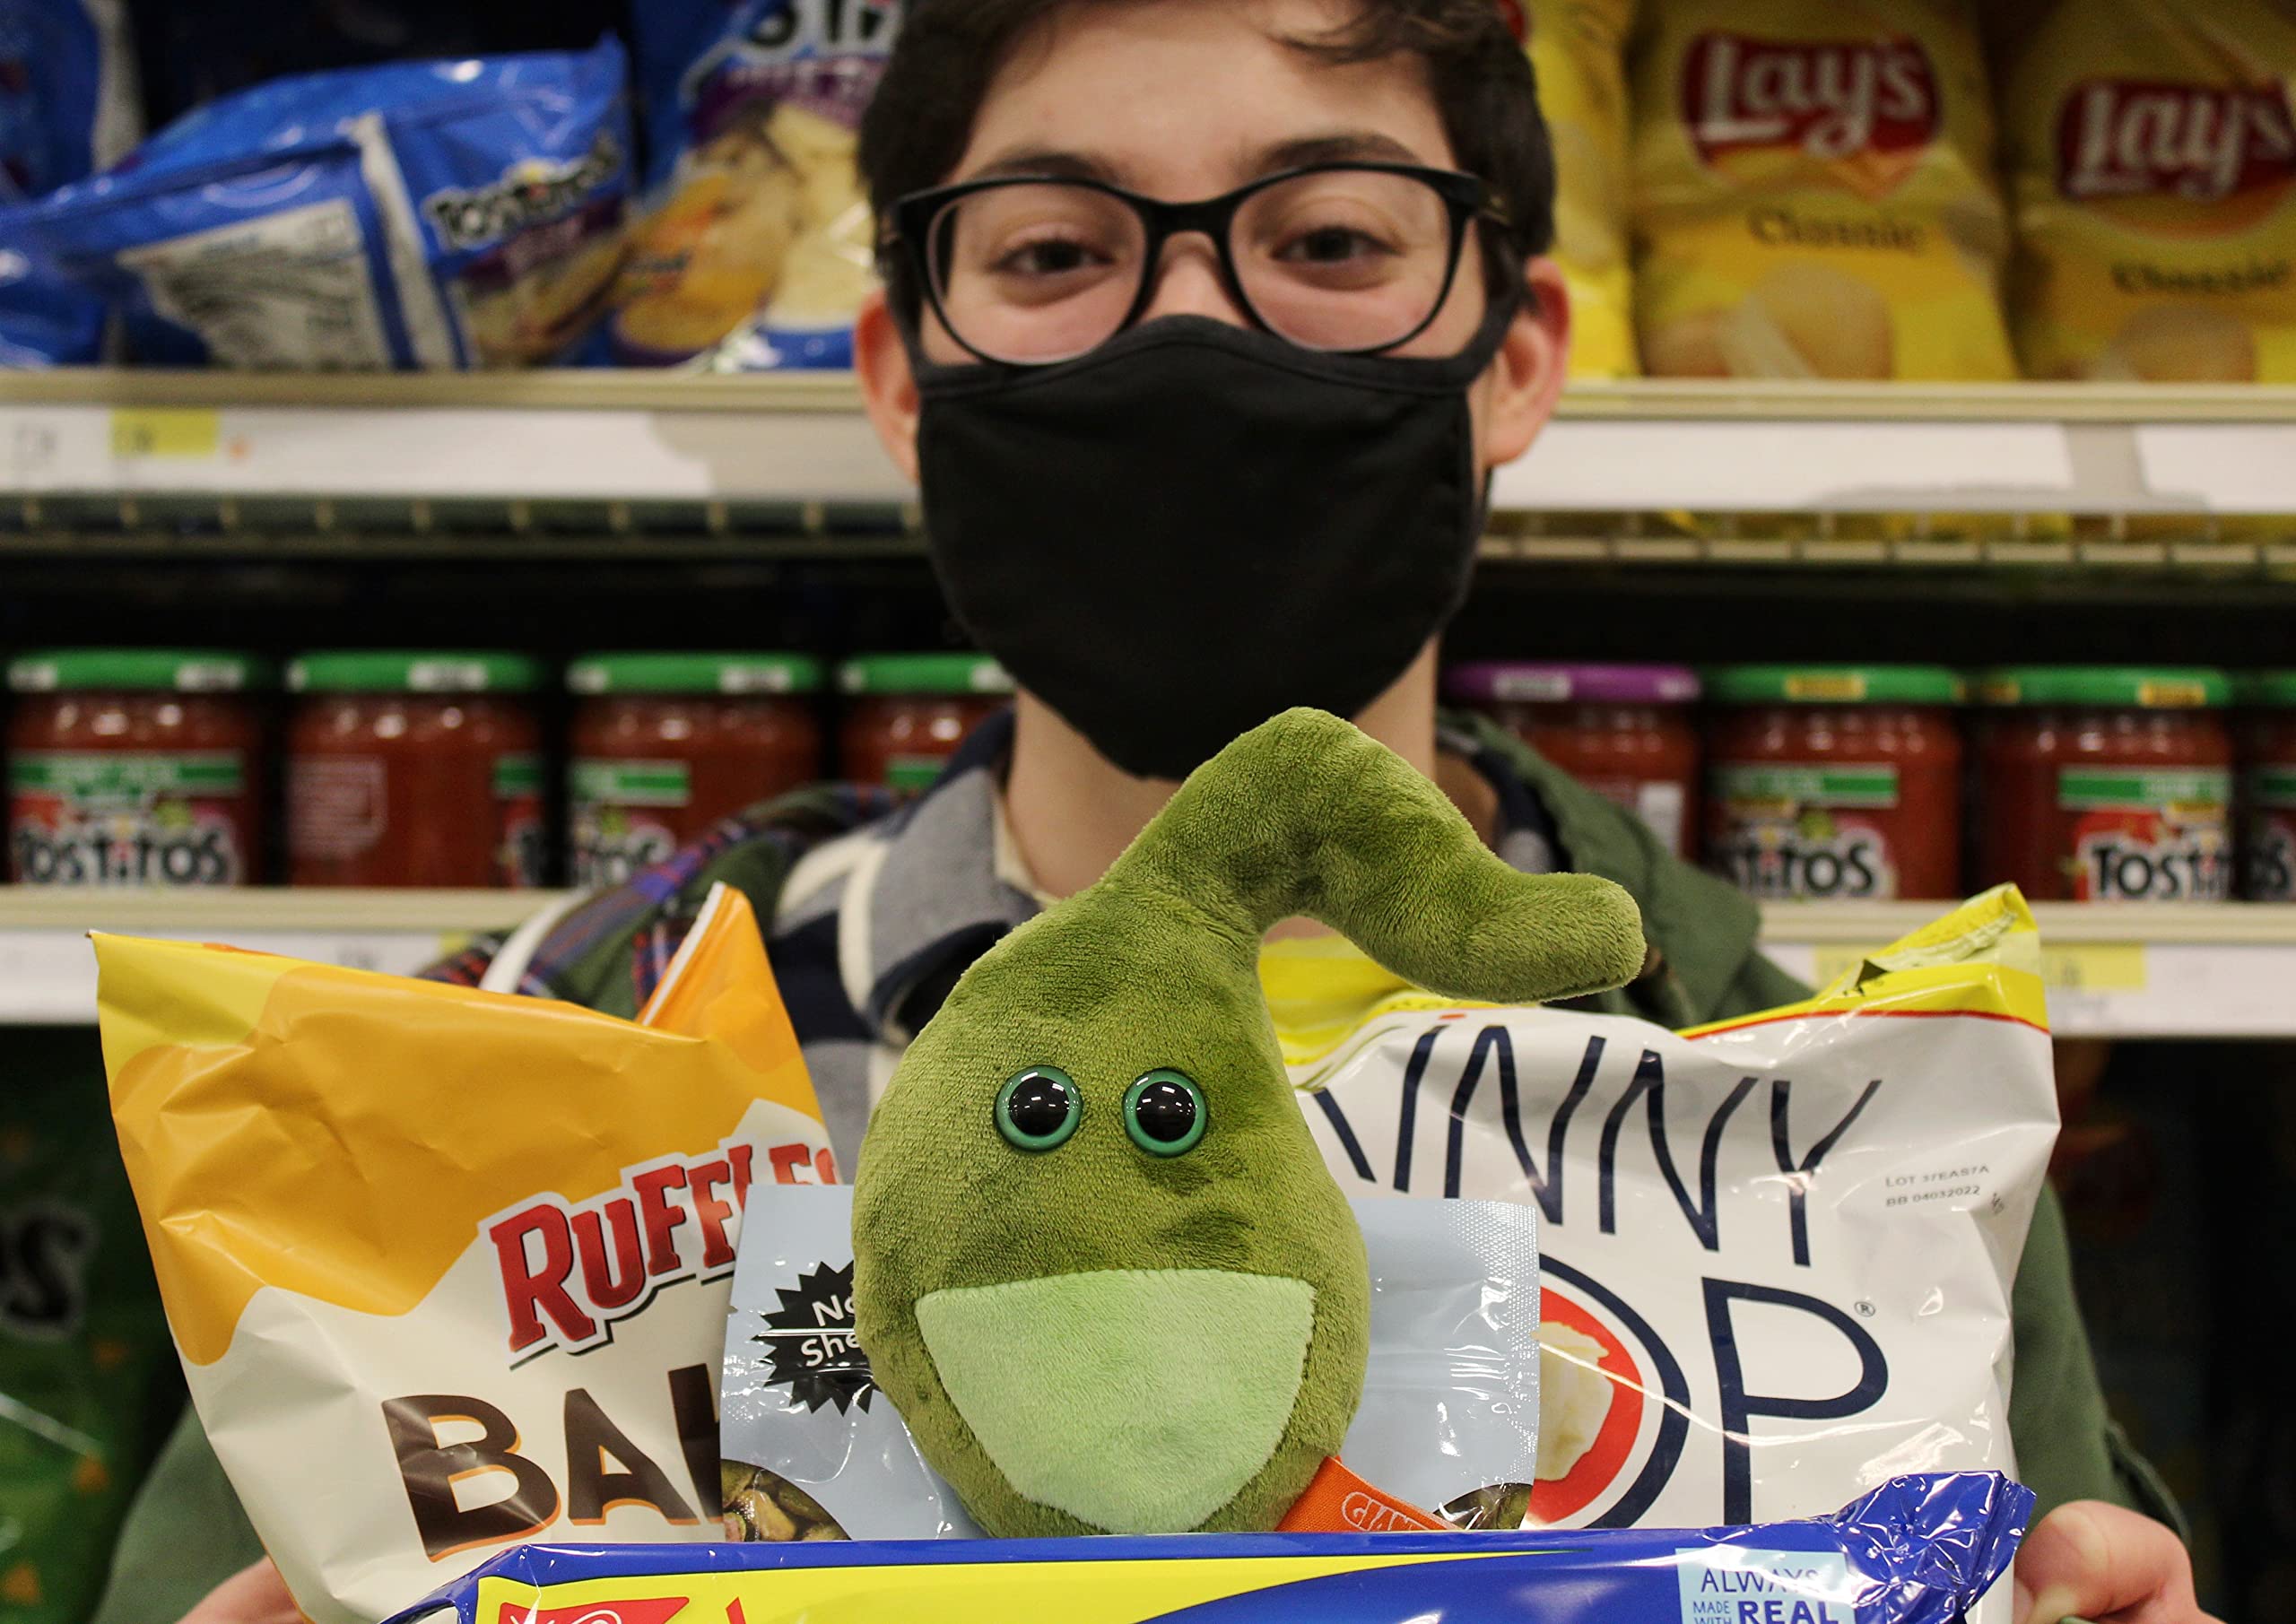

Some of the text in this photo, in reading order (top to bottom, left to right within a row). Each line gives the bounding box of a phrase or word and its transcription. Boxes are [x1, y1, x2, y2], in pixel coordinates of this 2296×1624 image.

[1885, 1176, 1917, 1187] LOT
[1886, 1196, 1909, 1207] BB
[1692, 1600, 1731, 1614] MADE
[1737, 1600, 1839, 1624] REAL
